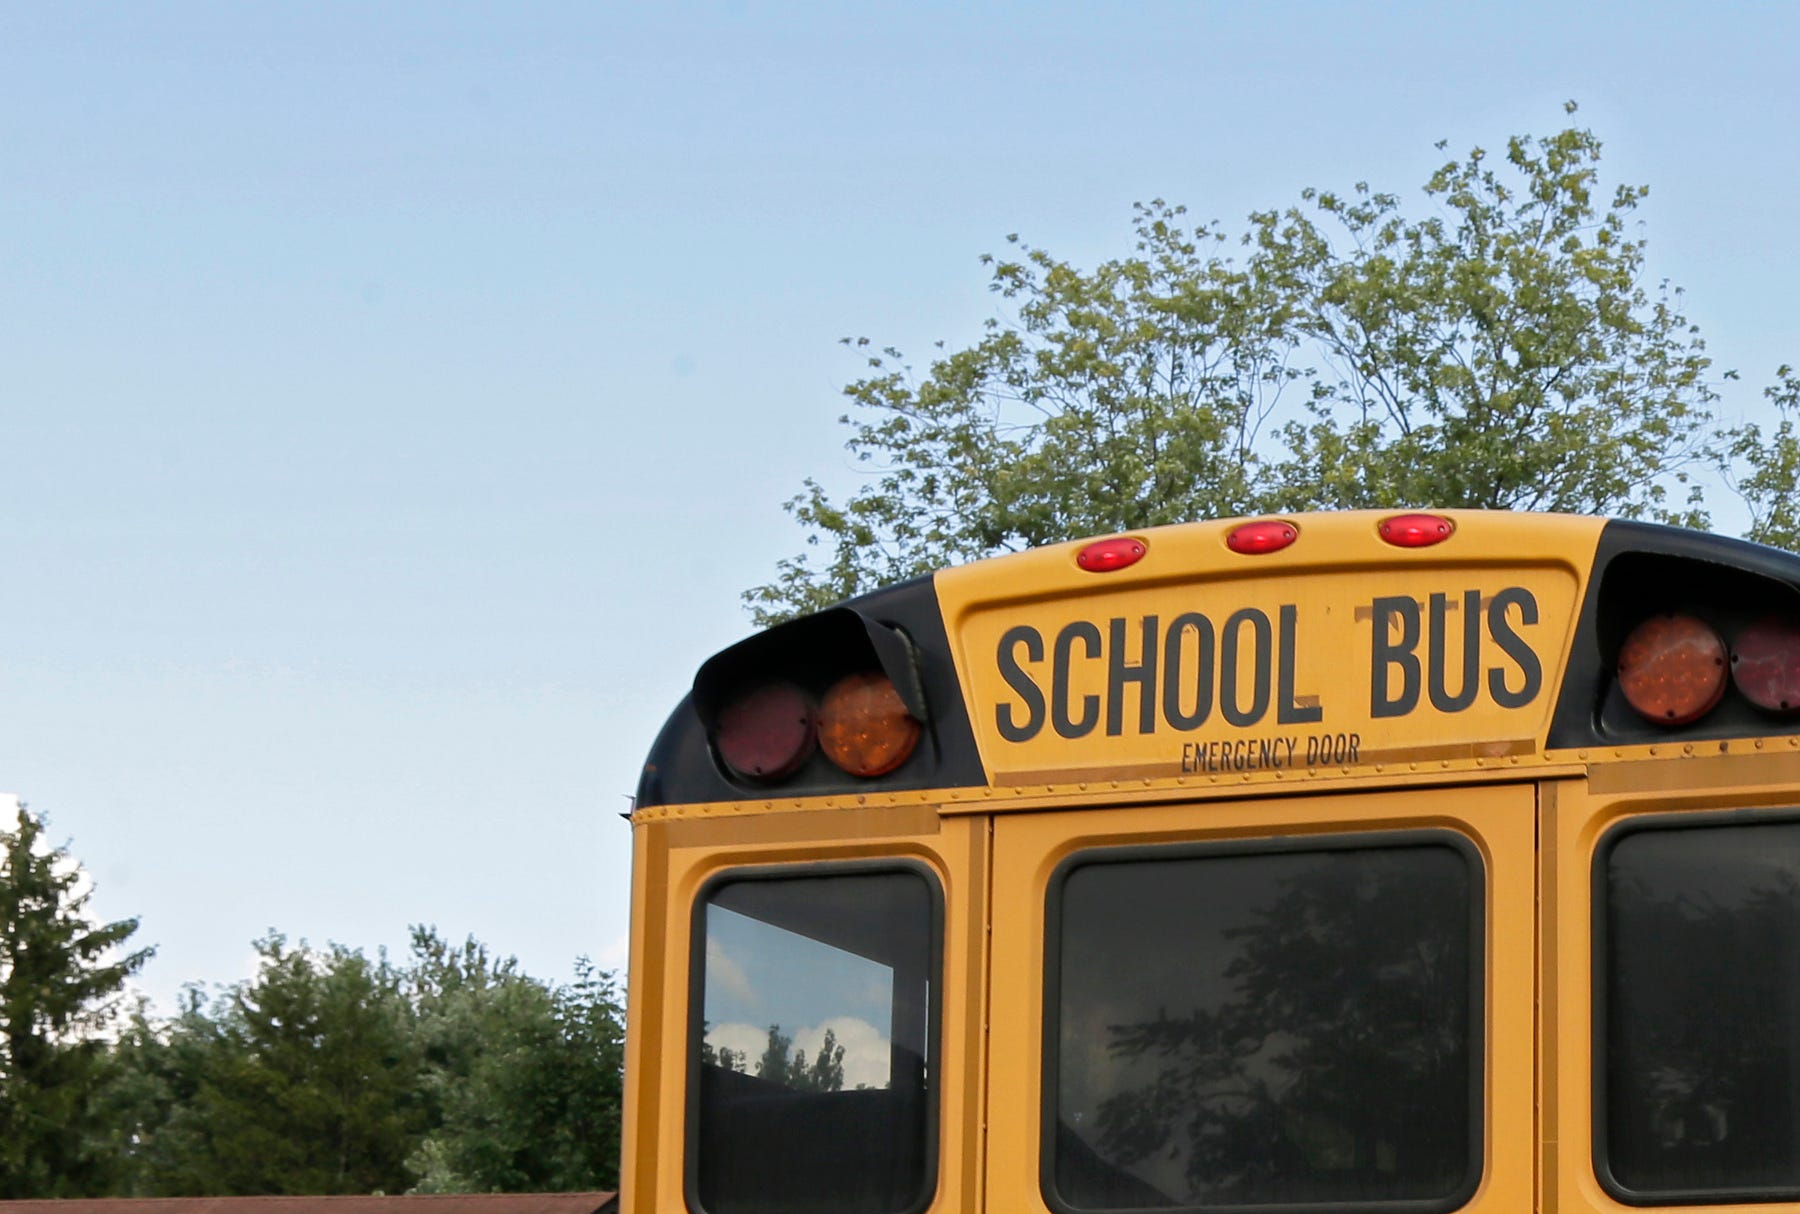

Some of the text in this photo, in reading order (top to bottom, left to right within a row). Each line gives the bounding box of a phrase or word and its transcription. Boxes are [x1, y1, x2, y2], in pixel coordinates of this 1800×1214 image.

[995, 586, 1542, 744] SCHOOL BUS
[1182, 733, 1361, 773] EMERGENCY DOOR
